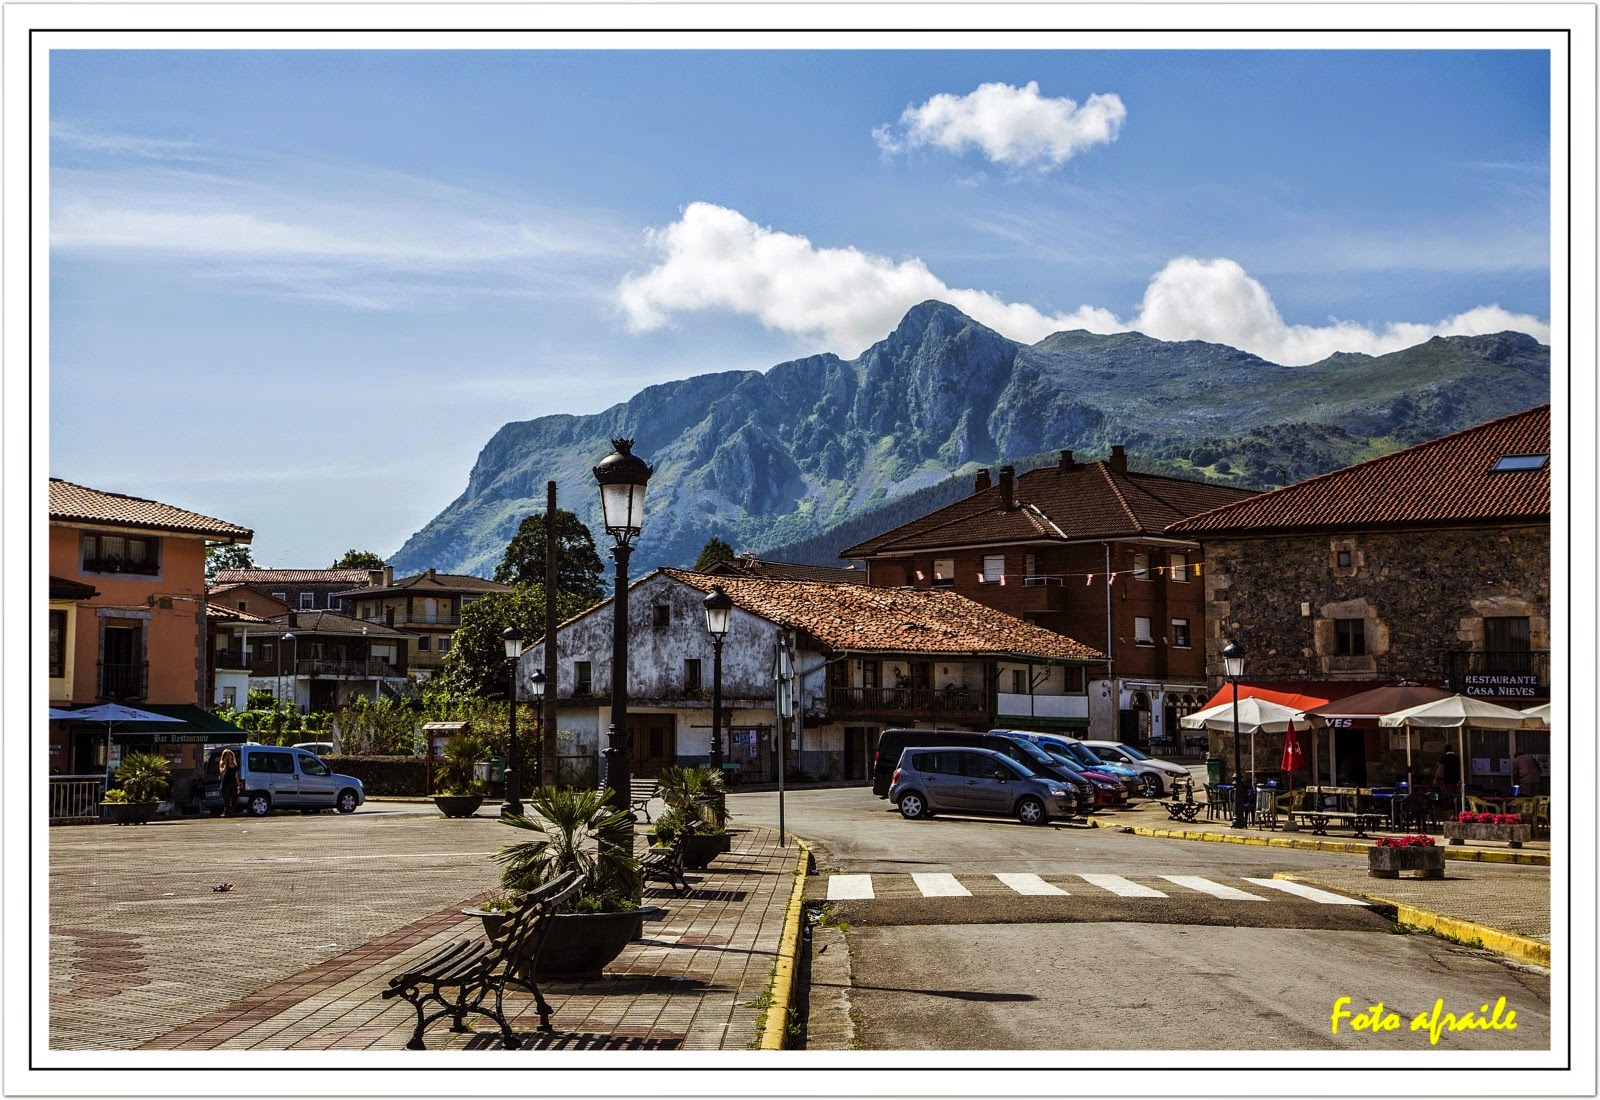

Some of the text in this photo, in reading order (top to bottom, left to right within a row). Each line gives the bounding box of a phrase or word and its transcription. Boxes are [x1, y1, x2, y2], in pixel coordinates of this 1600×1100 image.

[1465, 675, 1537, 685] RESTAURANTE
[1466, 685, 1535, 696] CASA NIEVES
[1324, 718, 1353, 728] VES
[153, 734, 209, 743] Bar Restaurante
